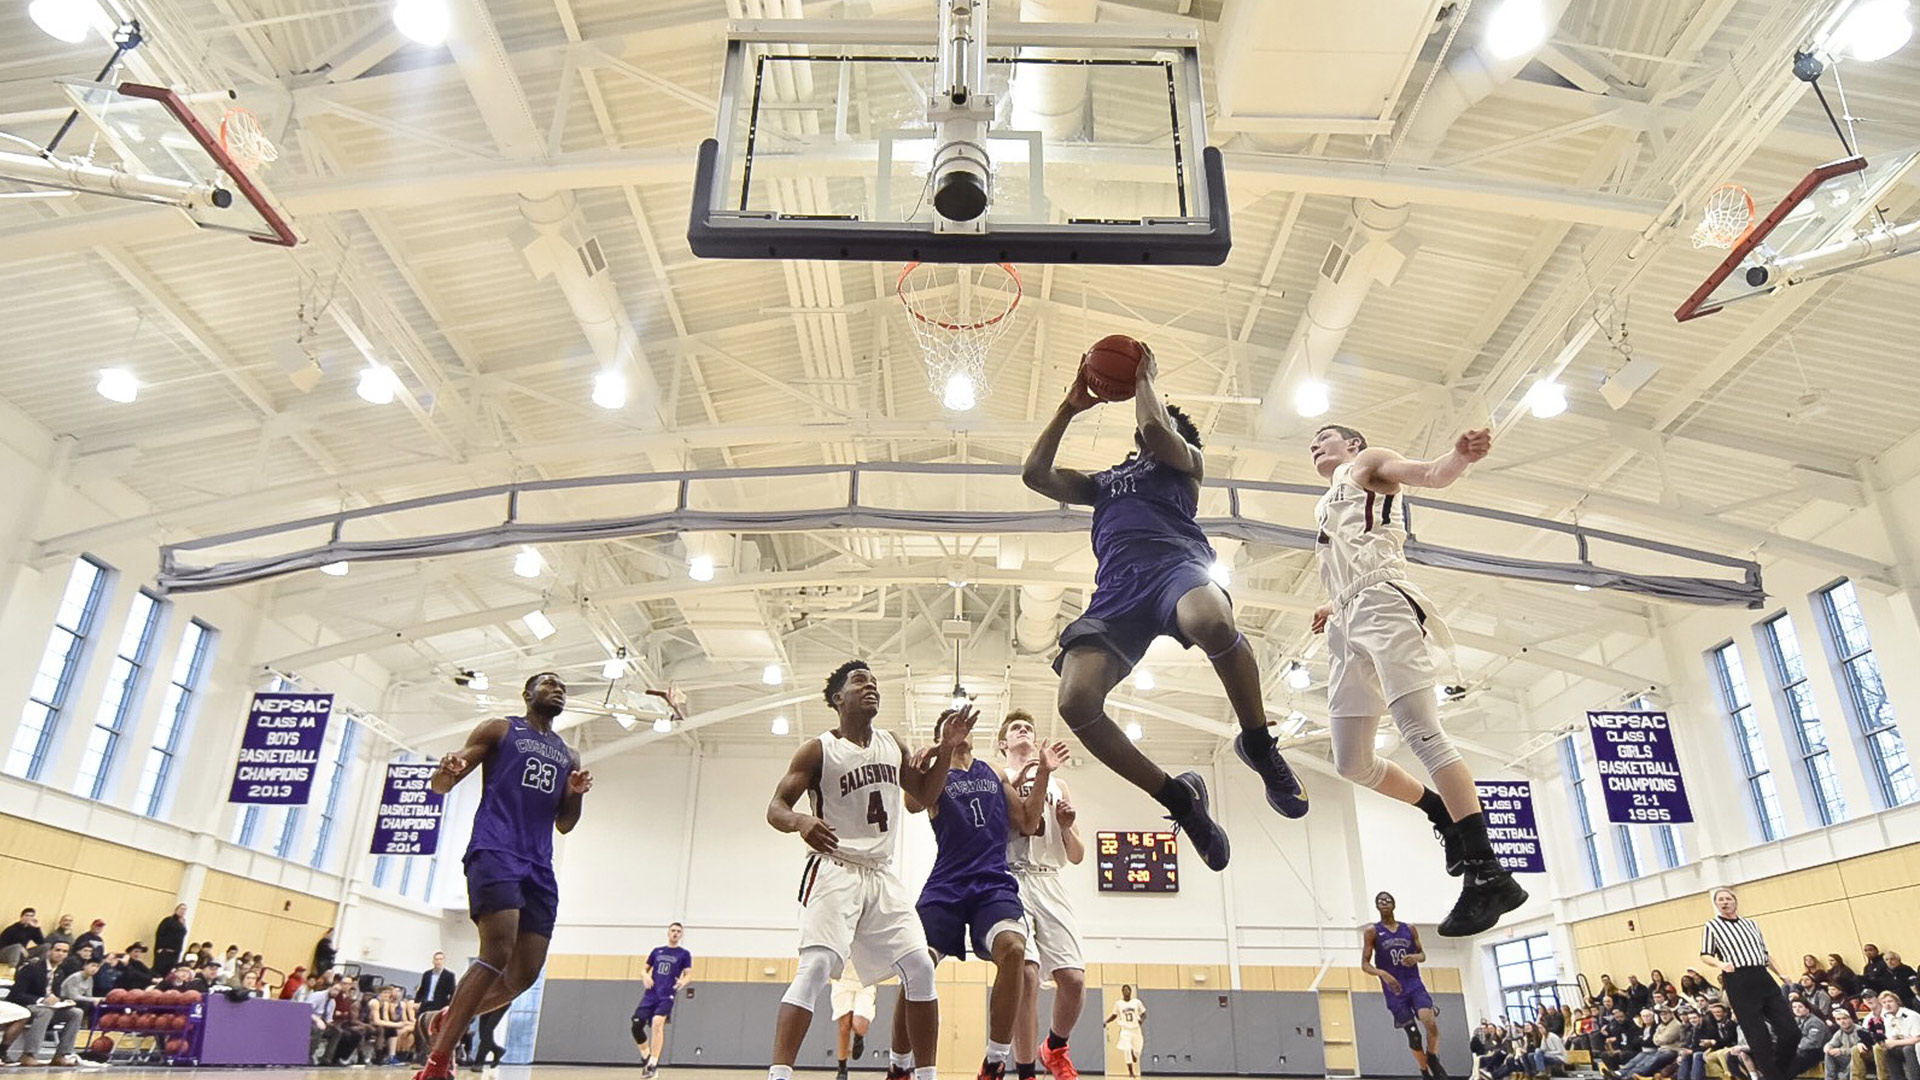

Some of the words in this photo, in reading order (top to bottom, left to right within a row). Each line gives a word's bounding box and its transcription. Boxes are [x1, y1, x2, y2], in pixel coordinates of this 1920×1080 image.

[252, 699, 330, 713] NEPSAC
[257, 716, 297, 728] CLASS
[299, 717, 316, 728] AA
[1589, 715, 1667, 728] NEPSAC
[266, 732, 300, 745] BOYS
[1606, 730, 1646, 742] CLASS
[1649, 731, 1658, 743] A
[238, 748, 317, 763] BASKETBALL
[1617, 744, 1653, 758] GIRLS
[238, 766, 309, 781] CHAMPIONS
[388, 767, 436, 779] NEPSA
[1599, 760, 1679, 776] BASKETBALL
[521, 756, 557, 794] 23
[393, 780, 424, 790] CLASS
[1608, 777, 1677, 792] CHAMPIONS
[248, 785, 292, 797] 2013
[399, 791, 427, 803] BOYS
[1476, 786, 1529, 797] EPSAC
[1633, 794, 1660, 806] 21-1
[379, 804, 442, 816] BASKETBALL
[866, 790, 889, 833] 4
[970, 797, 985, 827] 1
[1628, 808, 1671, 820] 1995
[381, 818, 436, 830] CHAMPIONS
[1488, 812, 1516, 824] BOYS
[1486, 827, 1538, 839] SKETBALL
[385, 842, 421, 853] 2014
[1101, 840, 1118, 854] 22
[1490, 842, 1535, 854] AMPIONS
[1104, 870, 1112, 881] 4
[1167, 871, 1175, 882] 4
[657, 961, 671, 975] 10
